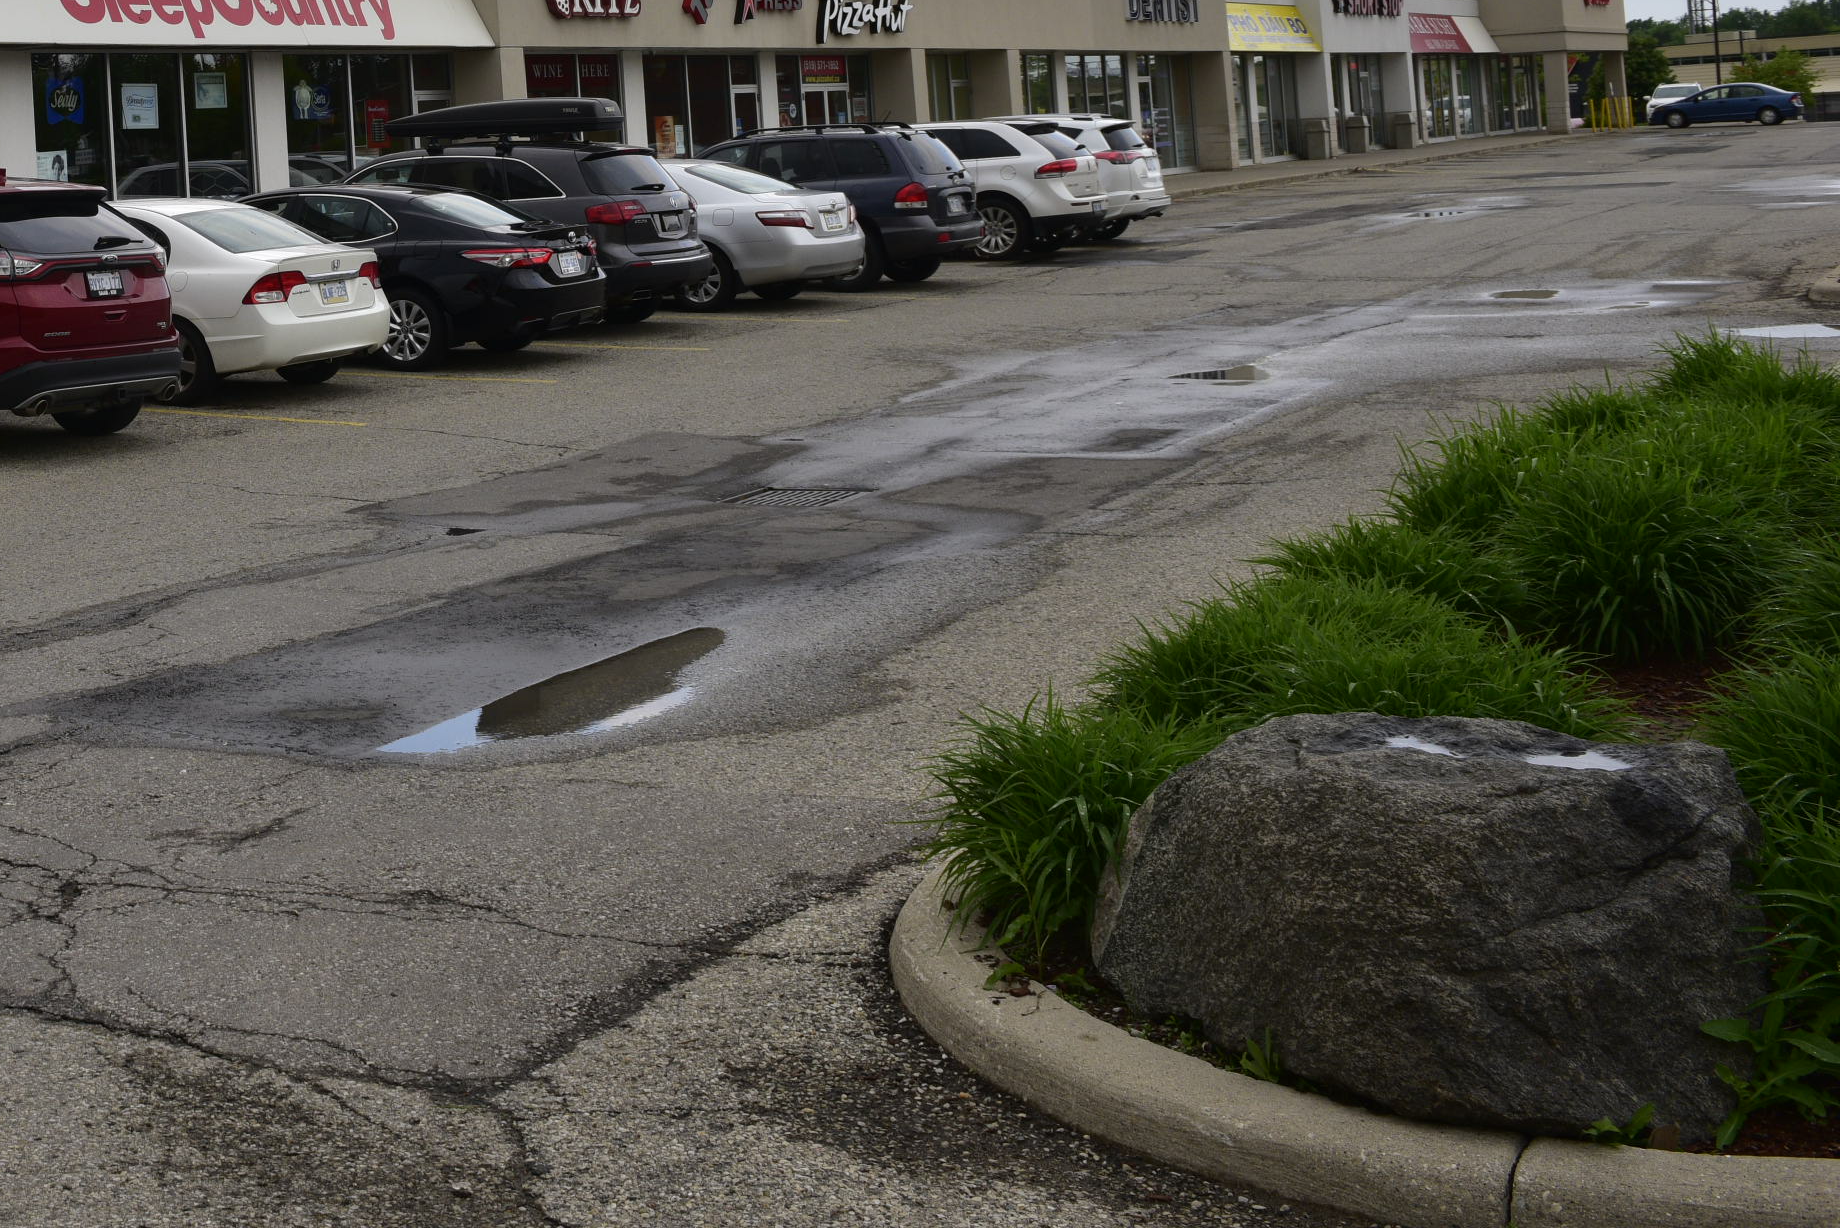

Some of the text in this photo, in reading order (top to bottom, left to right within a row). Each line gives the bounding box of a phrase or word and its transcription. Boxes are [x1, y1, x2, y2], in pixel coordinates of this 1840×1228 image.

[532, 63, 610, 78] WINE HERE
[51, 89, 79, 111] Sealy
